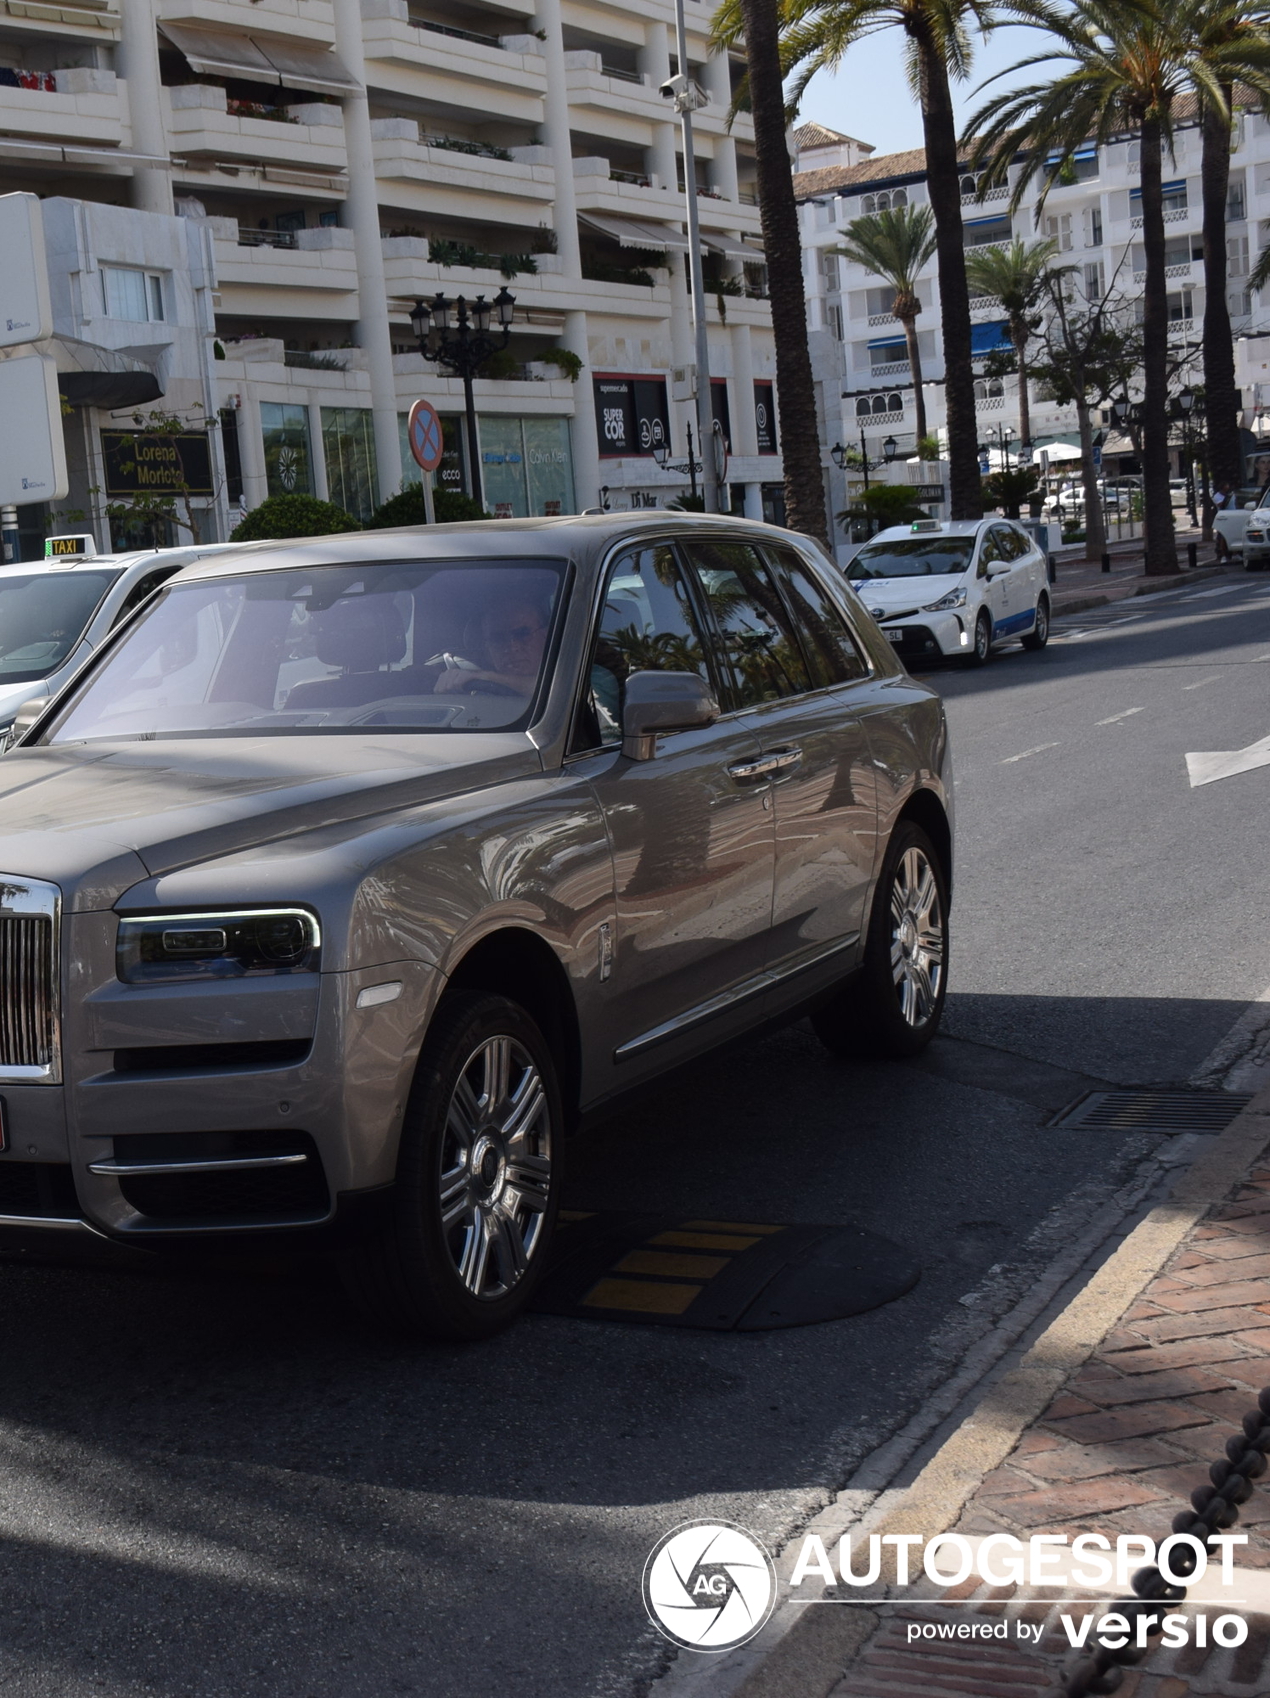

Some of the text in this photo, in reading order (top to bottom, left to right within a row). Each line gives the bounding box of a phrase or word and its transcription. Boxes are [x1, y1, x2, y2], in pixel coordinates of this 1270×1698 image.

[603, 408, 624, 421] SUPER
[604, 421, 625, 440] COR
[134, 442, 176, 461] Lorena
[442, 469, 461, 480] ecco
[53, 539, 77, 555] TAXI
